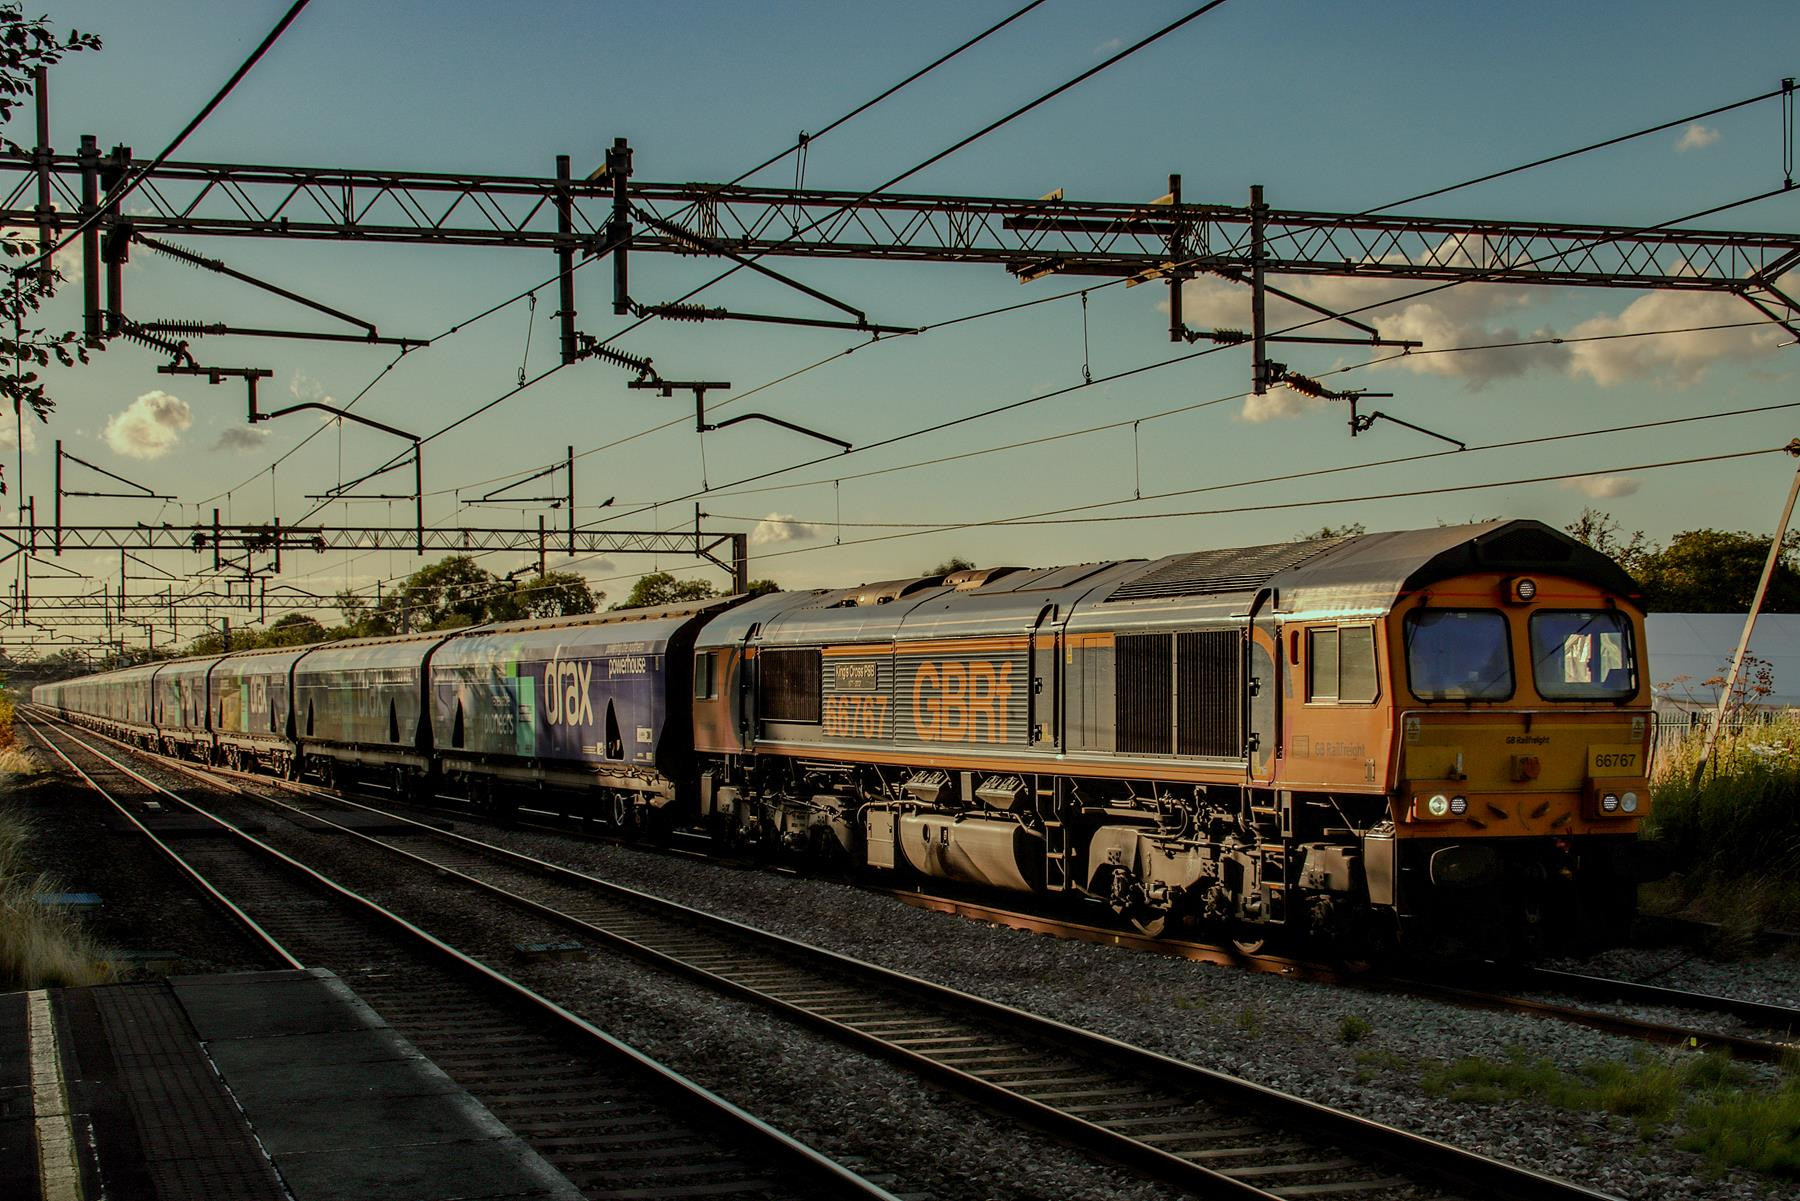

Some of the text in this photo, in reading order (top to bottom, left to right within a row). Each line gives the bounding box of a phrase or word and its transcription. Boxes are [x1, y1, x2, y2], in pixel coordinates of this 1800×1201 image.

[608, 655, 646, 679] powerhouse
[850, 664, 864, 678] Cross
[864, 664, 875, 677] PSB
[544, 643, 593, 726] drax
[912, 660, 1013, 744] GBRf
[825, 695, 888, 739] 66767
[1505, 736, 1550, 746] GB Railfreight
[1595, 753, 1636, 768] 66767
